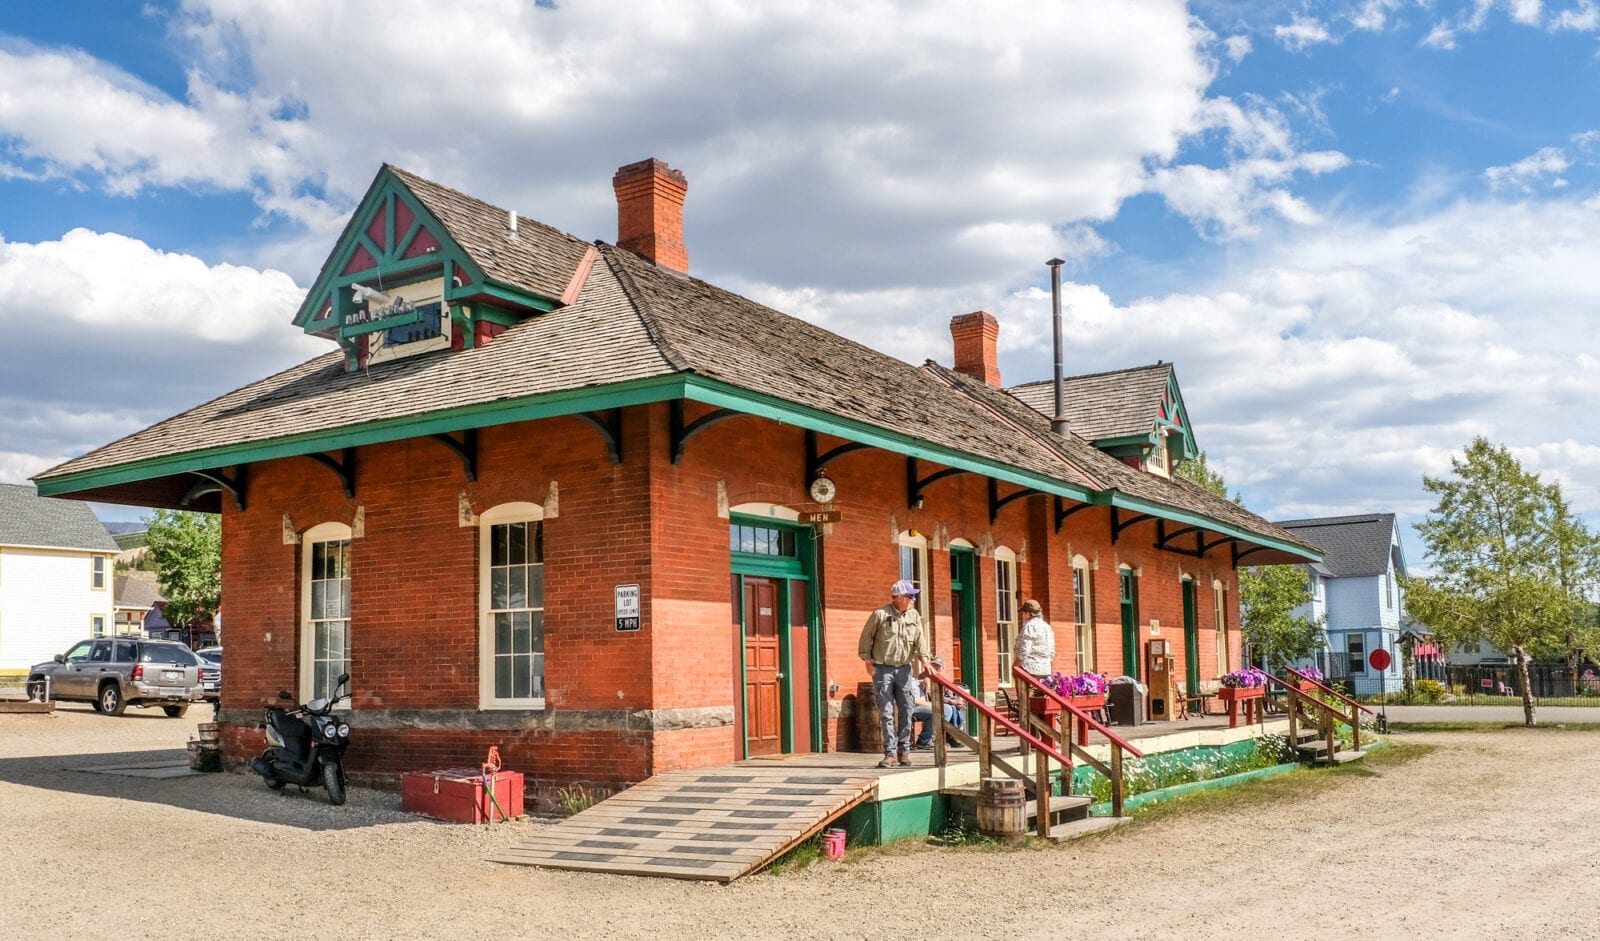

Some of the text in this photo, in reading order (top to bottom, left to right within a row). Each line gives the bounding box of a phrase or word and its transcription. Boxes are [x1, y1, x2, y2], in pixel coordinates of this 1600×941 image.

[810, 513, 828, 521] MEN
[618, 619, 637, 629] 5 MPH
